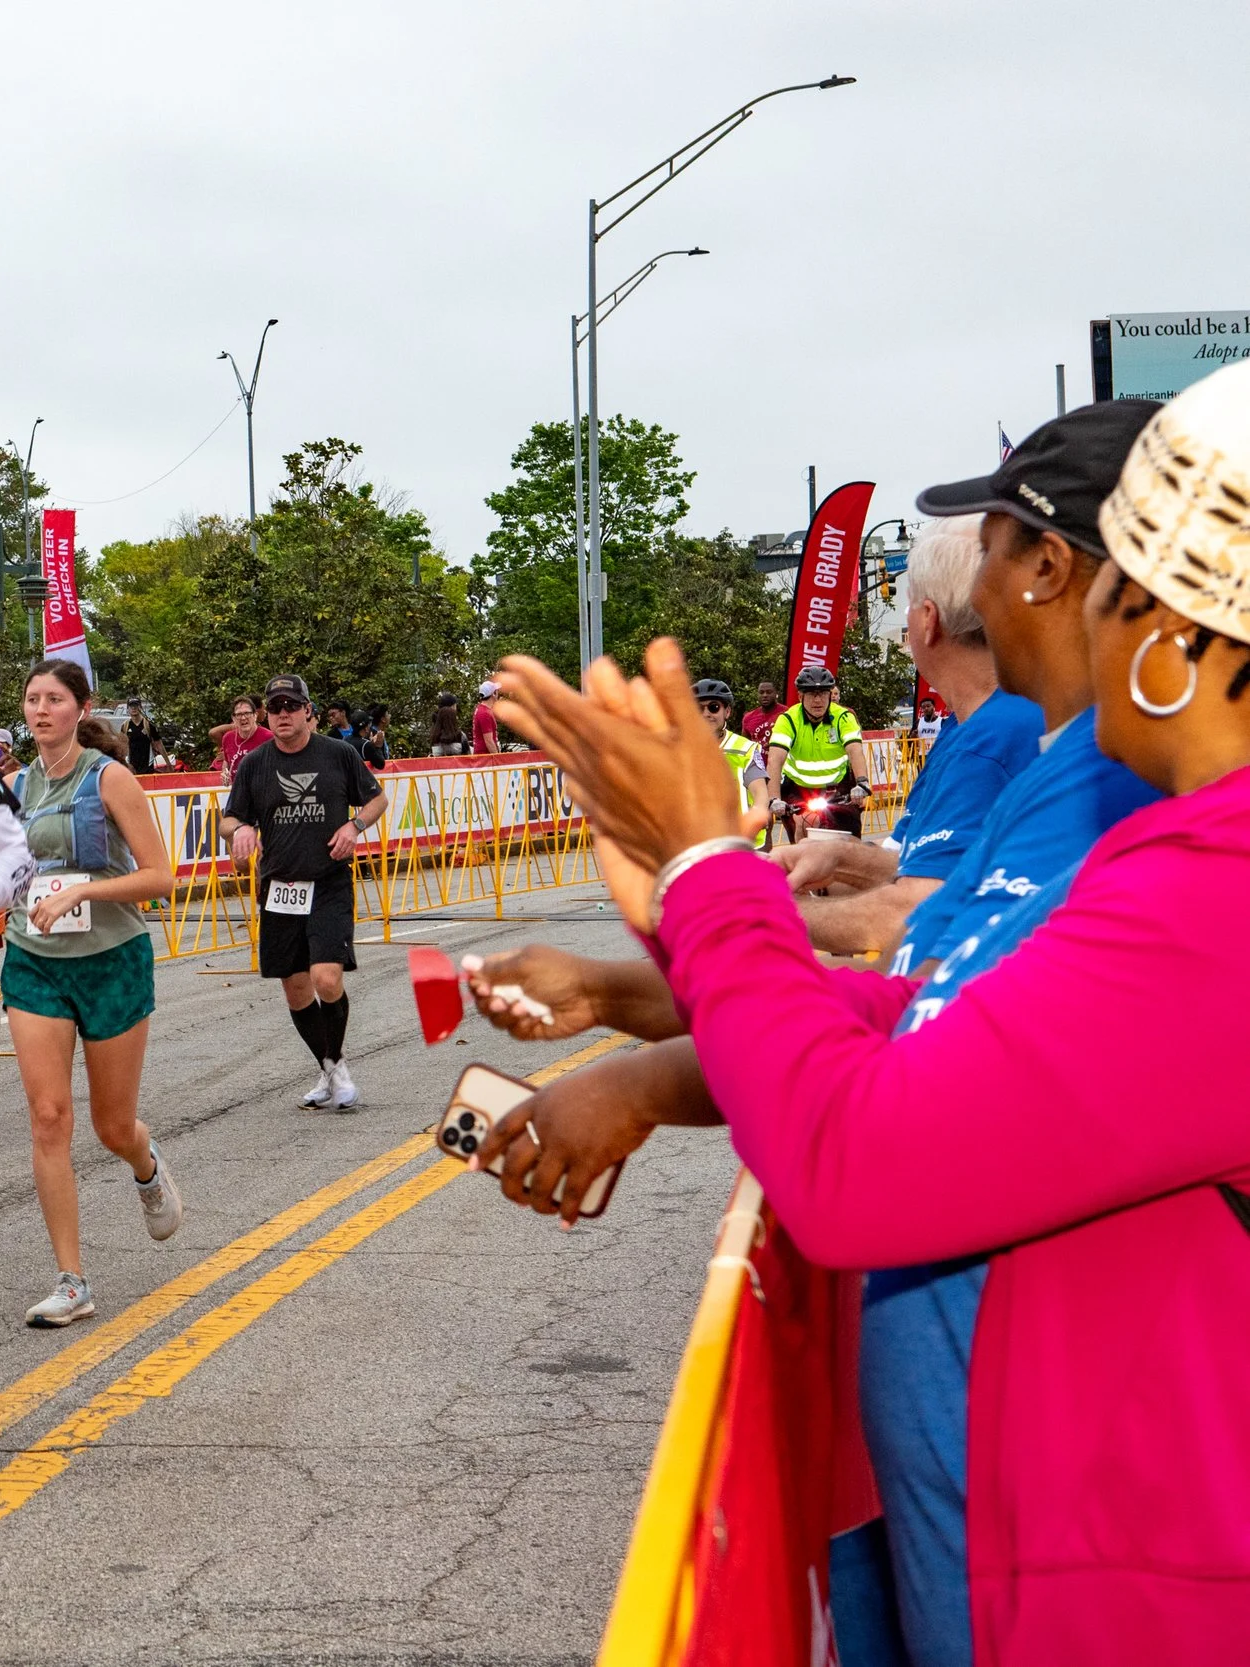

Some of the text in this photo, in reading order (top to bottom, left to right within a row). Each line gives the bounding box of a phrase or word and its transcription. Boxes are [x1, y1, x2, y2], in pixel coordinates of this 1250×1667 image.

[1116, 319, 1150, 337] You
[1155, 317, 1202, 337] could
[1206, 317, 1227, 335] be
[1231, 323, 1241, 334] a
[1192, 343, 1239, 363] Adopt
[45, 528, 63, 624] VOLUNTEER
[58, 538, 77, 616] CHECK-IN
[801, 523, 847, 668] VE FOR GRADY
[273, 804, 326, 819] ATLANTA
[427, 792, 495, 827] REGION
[274, 817, 300, 825] TRACK
[273, 887, 308, 906] 3039
